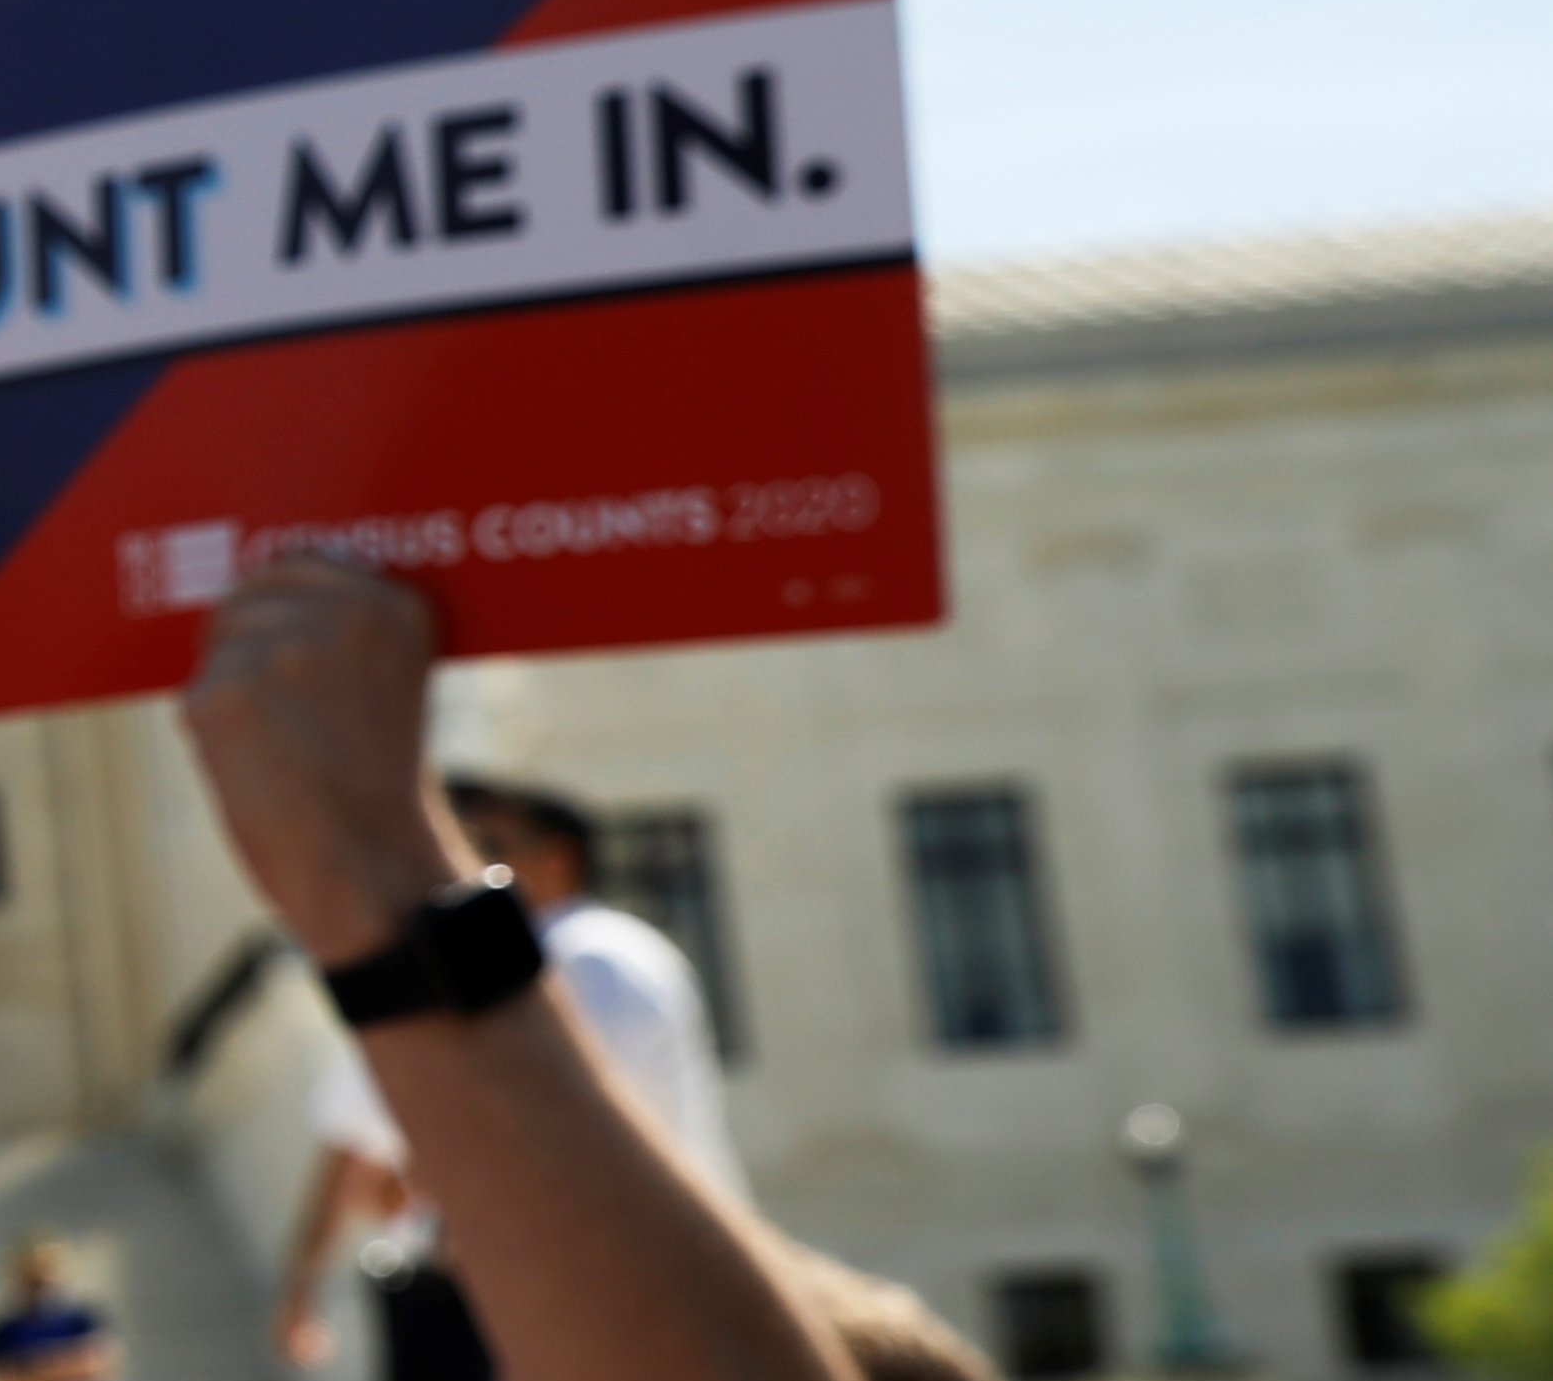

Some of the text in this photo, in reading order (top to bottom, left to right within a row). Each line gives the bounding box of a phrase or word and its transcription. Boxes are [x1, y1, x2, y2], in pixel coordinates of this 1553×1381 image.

[278, 105, 522, 268] ME
[593, 67, 843, 222] IN.
[472, 484, 720, 562] COUNTS
[722, 471, 882, 543] 2020
